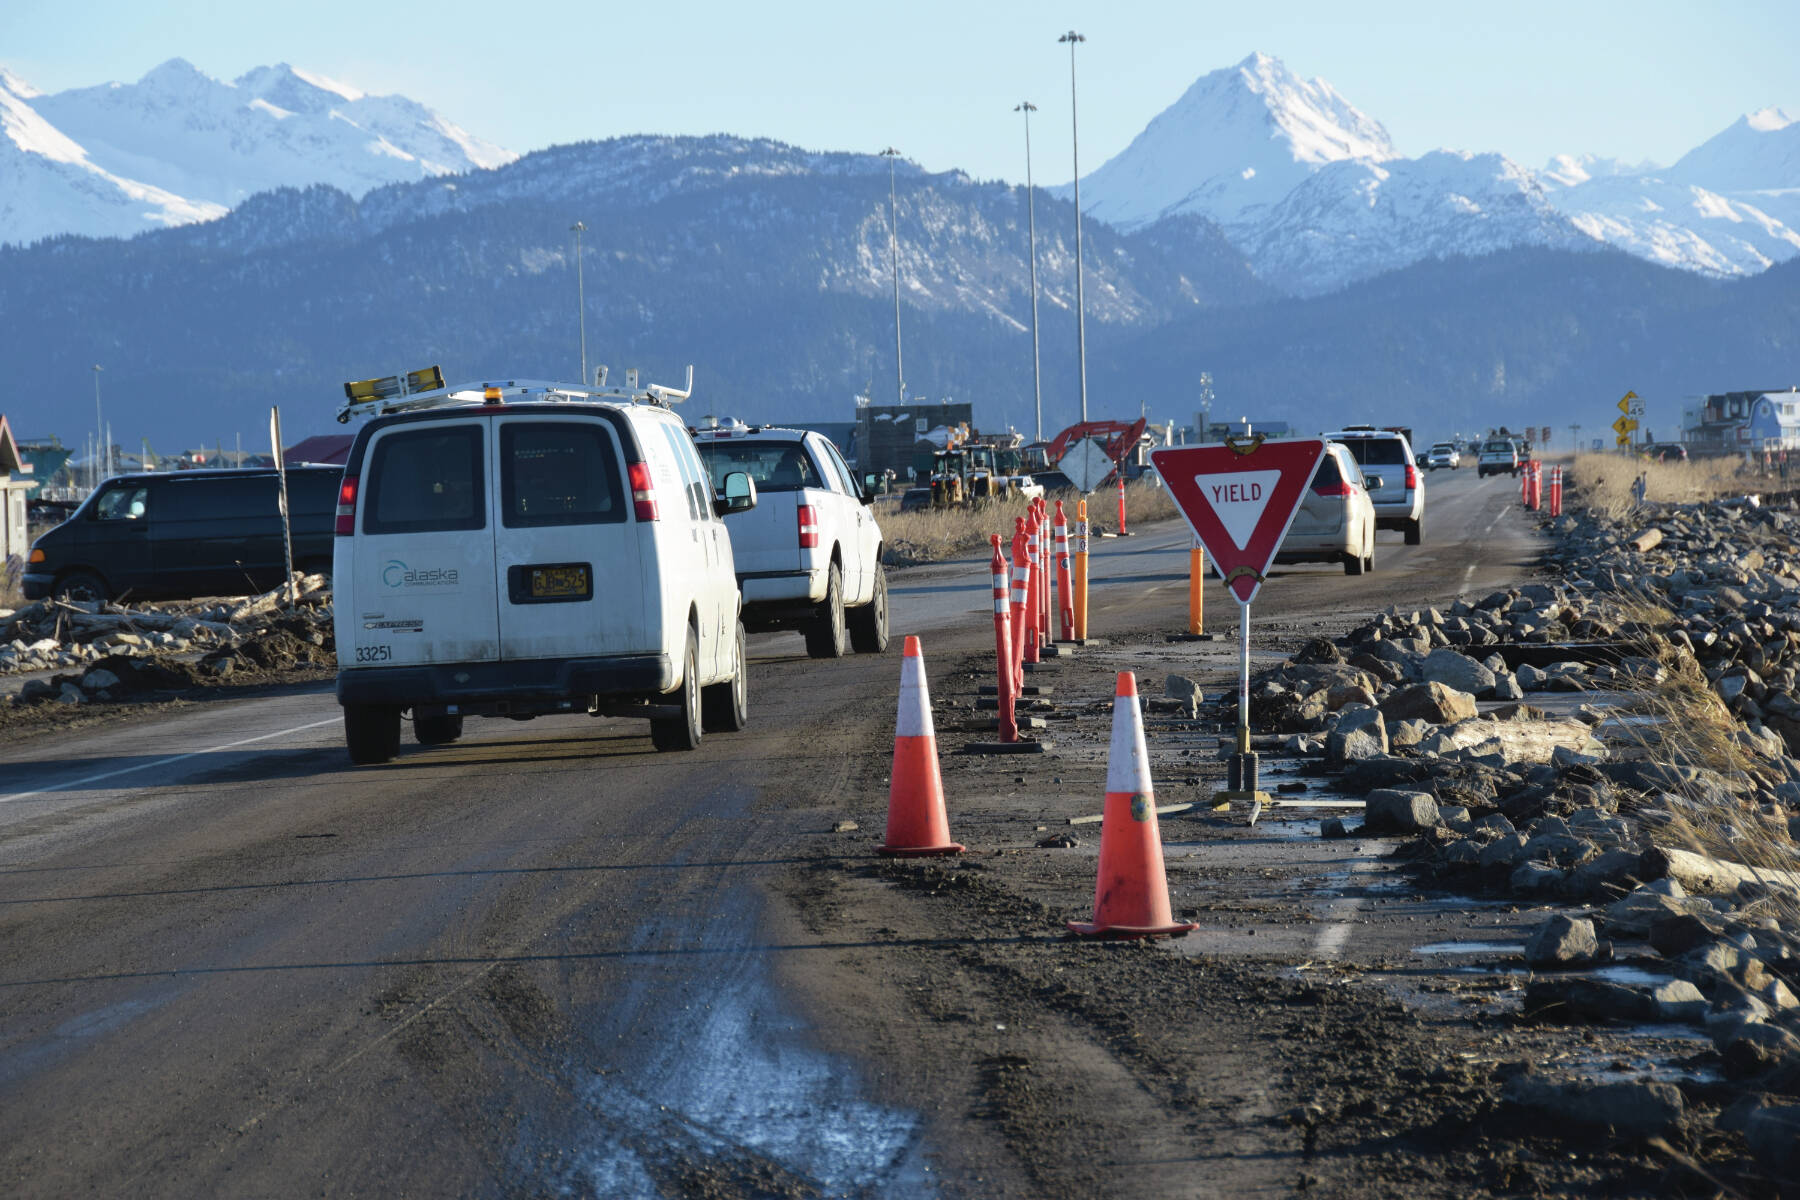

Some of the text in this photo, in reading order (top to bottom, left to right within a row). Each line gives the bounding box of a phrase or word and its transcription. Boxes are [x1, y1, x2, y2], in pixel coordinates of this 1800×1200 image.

[1630, 407, 1645, 416] 45
[1212, 483, 1261, 503] YIELD
[404, 568, 458, 581] alaska
[356, 645, 392, 662] 33251
